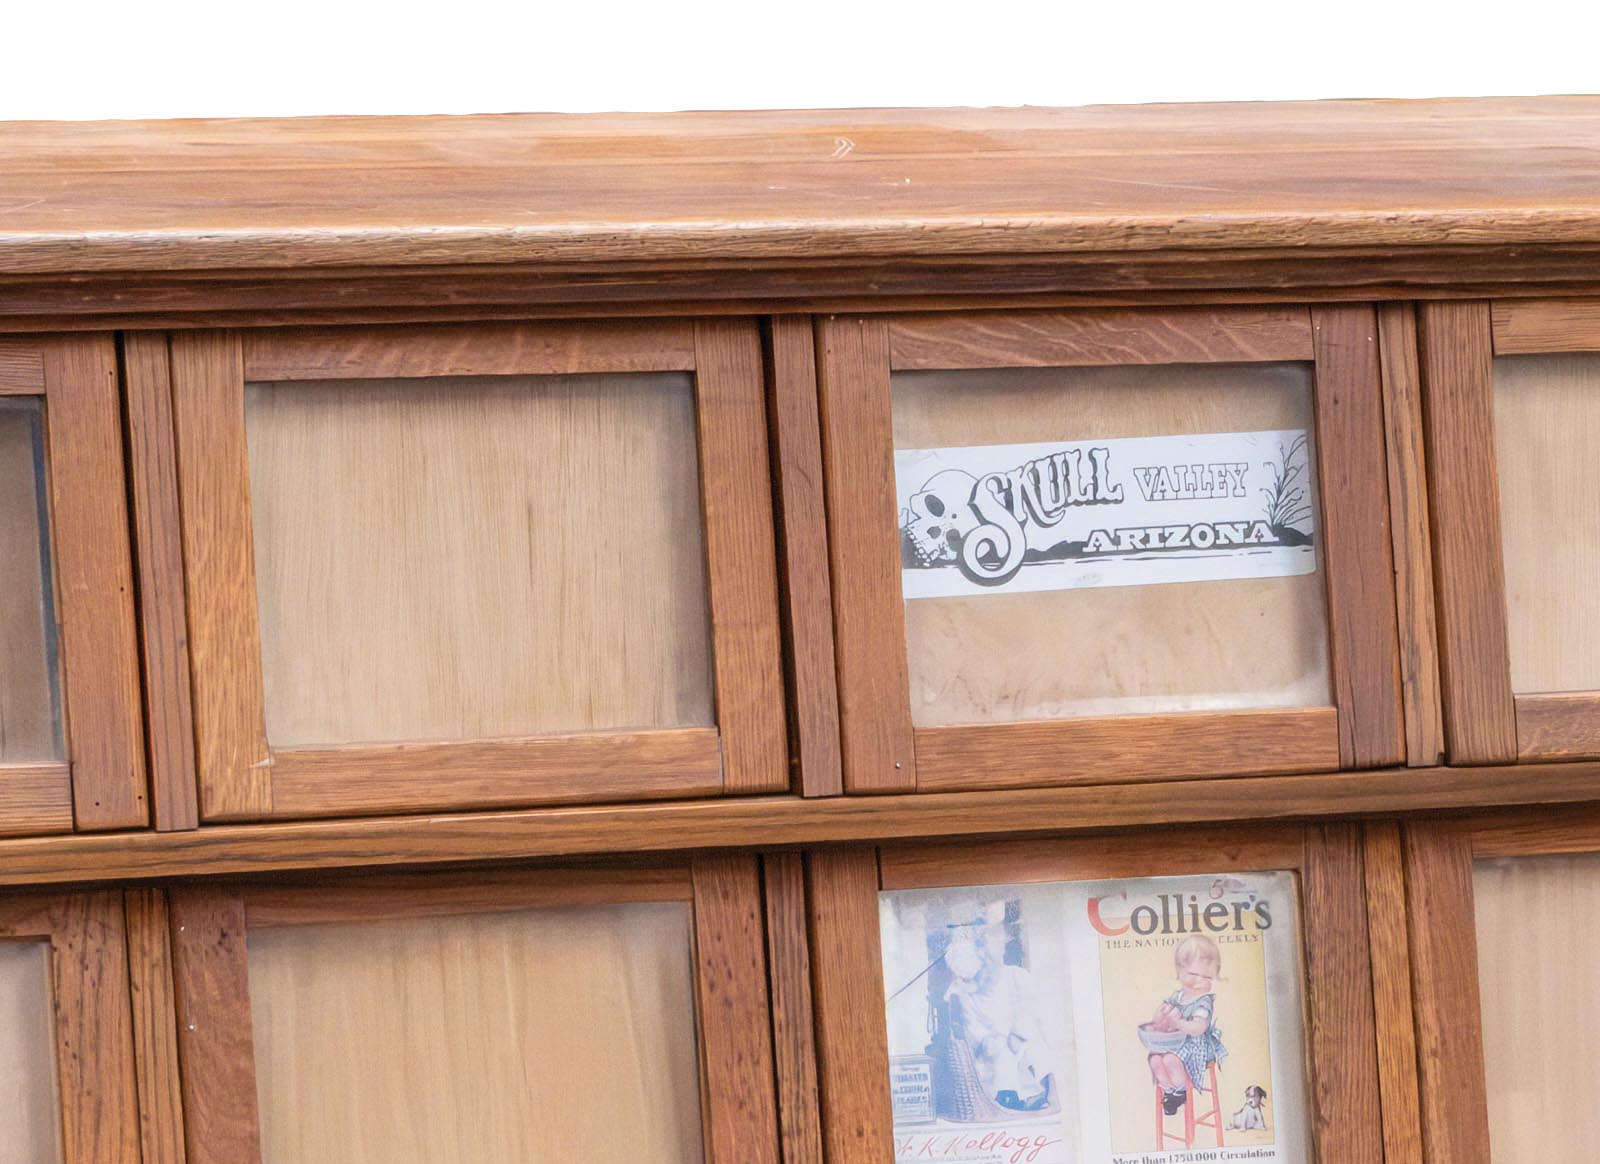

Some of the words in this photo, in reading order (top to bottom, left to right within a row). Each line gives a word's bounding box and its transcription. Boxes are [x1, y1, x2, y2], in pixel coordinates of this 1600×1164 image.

[957, 448, 1123, 586] SKULL
[1133, 463, 1248, 501] VALLEY
[1082, 520, 1280, 553] ARIZONA
[1088, 892, 1272, 936] Collier's
[1105, 940, 1131, 949] THE
[943, 1131, 1062, 1164] Kellogg
[1142, 1154, 1166, 1164] than
[1220, 1147, 1276, 1161] Circulation
